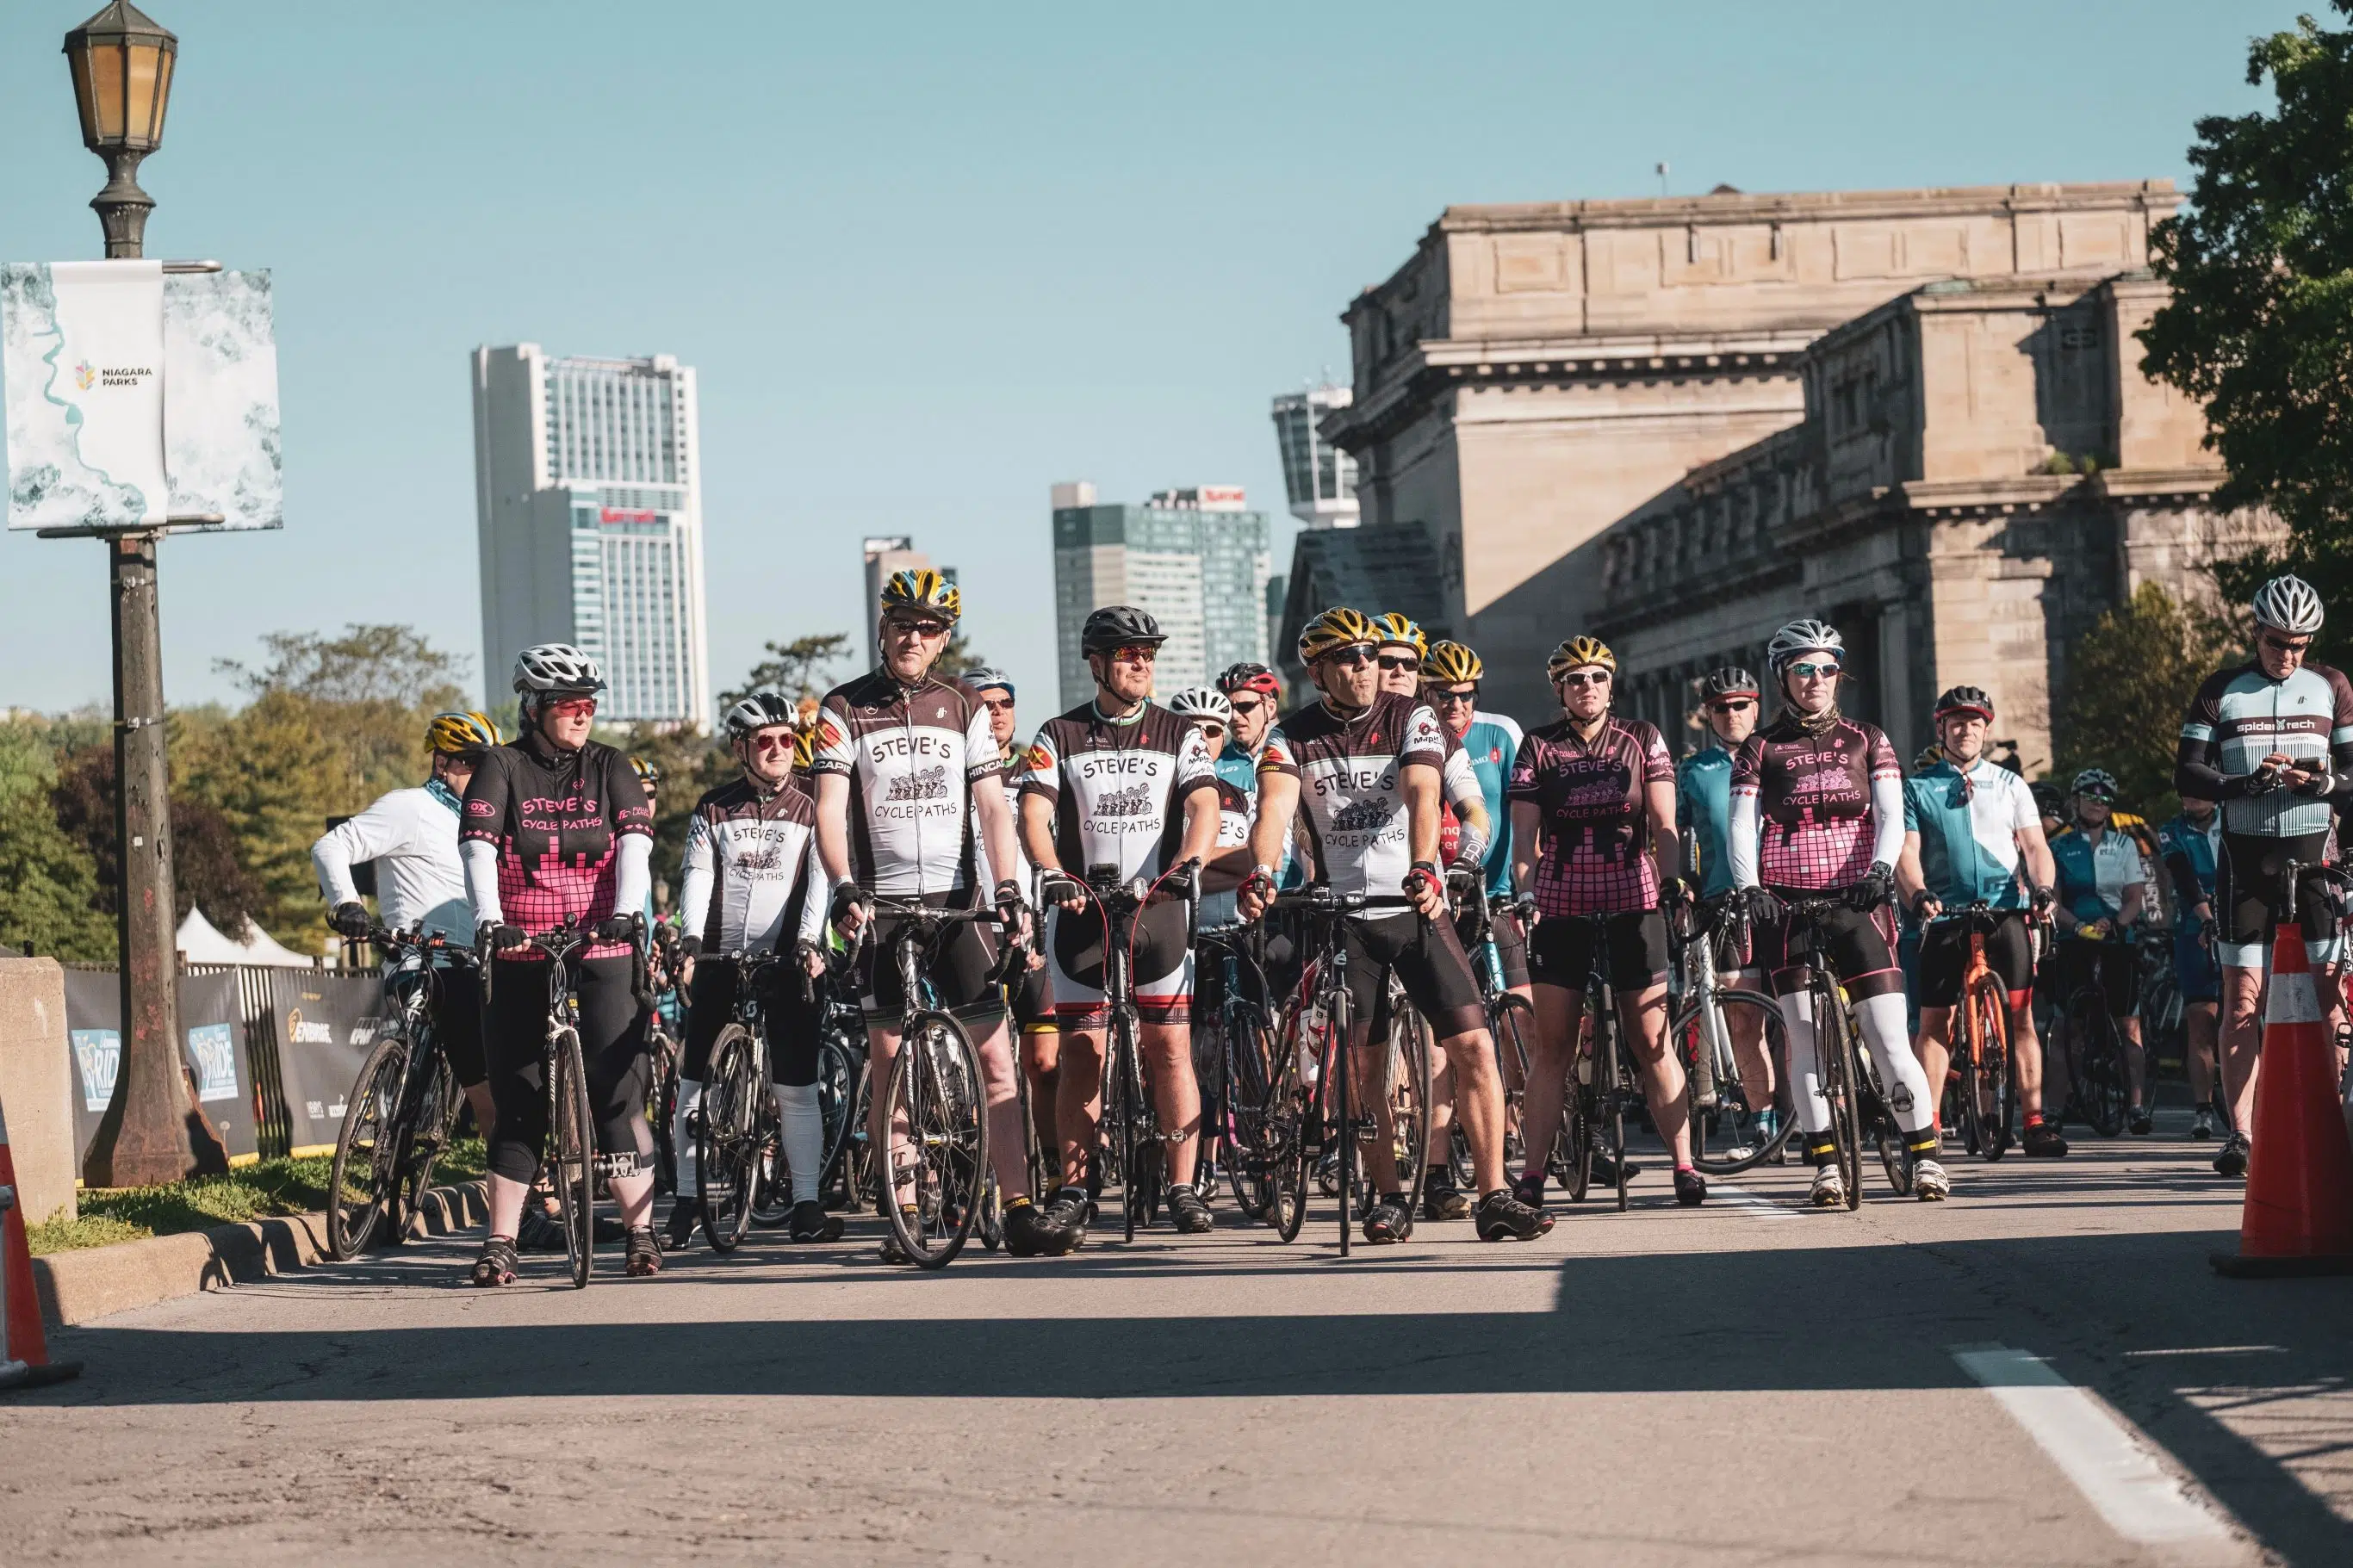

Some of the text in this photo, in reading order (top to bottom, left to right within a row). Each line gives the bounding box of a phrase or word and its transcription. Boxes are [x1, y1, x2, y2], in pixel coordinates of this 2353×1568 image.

[872, 737, 951, 763] STEVE'S
[1083, 758, 1158, 778] STEVE'S
[1559, 759, 1622, 777] STEVE'S
[1785, 752, 1848, 770] STEVE'S
[1511, 767, 1533, 783] OX
[1314, 772, 1394, 796] STEVE'S
[522, 796, 598, 815] STEVE'S
[1783, 790, 1860, 806] CYCLE PATHS
[875, 806, 913, 819] CYCLE
[916, 803, 957, 818] PATHS
[1556, 803, 1630, 819] CYCLE PATHS
[522, 817, 602, 830] CYCLE PATHS
[1083, 818, 1161, 834] CYCLE PATHS
[734, 827, 785, 843] STEVE'S
[1325, 829, 1405, 847] CYCLE PATHS
[729, 868, 784, 881] CYCLE PATHS
[95, 1049, 121, 1089] RID
